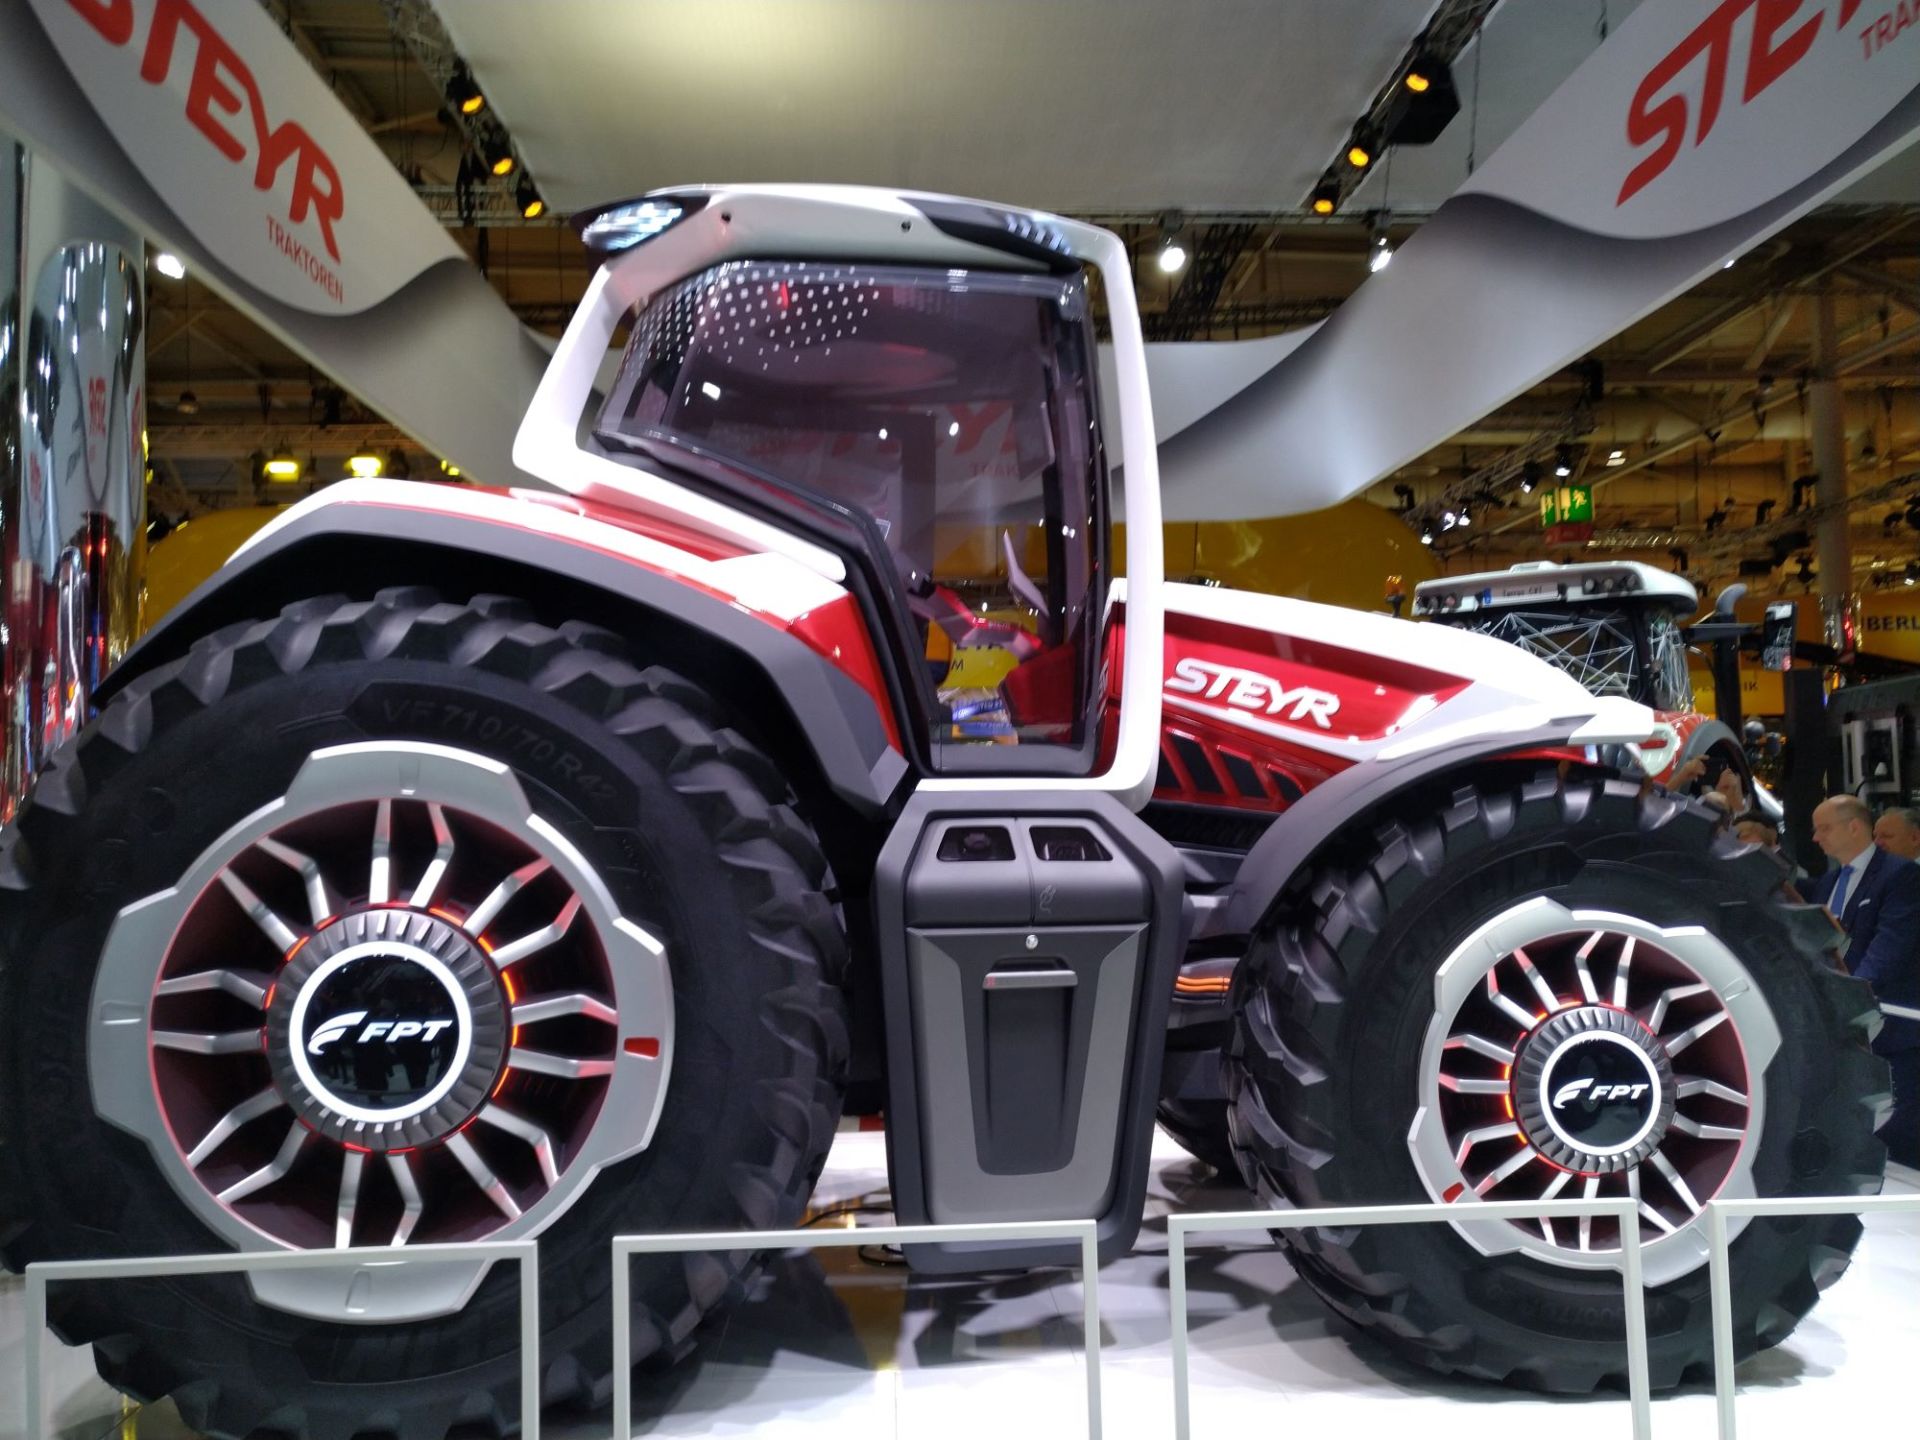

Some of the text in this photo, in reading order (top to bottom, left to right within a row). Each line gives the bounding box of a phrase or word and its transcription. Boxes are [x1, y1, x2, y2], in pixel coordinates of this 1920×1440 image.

[266, 213, 344, 304] TRAKTOREN
[1165, 657, 1341, 729] STEYR
[356, 1019, 453, 1044] FPT
[1588, 1083, 1649, 1100] FPT
